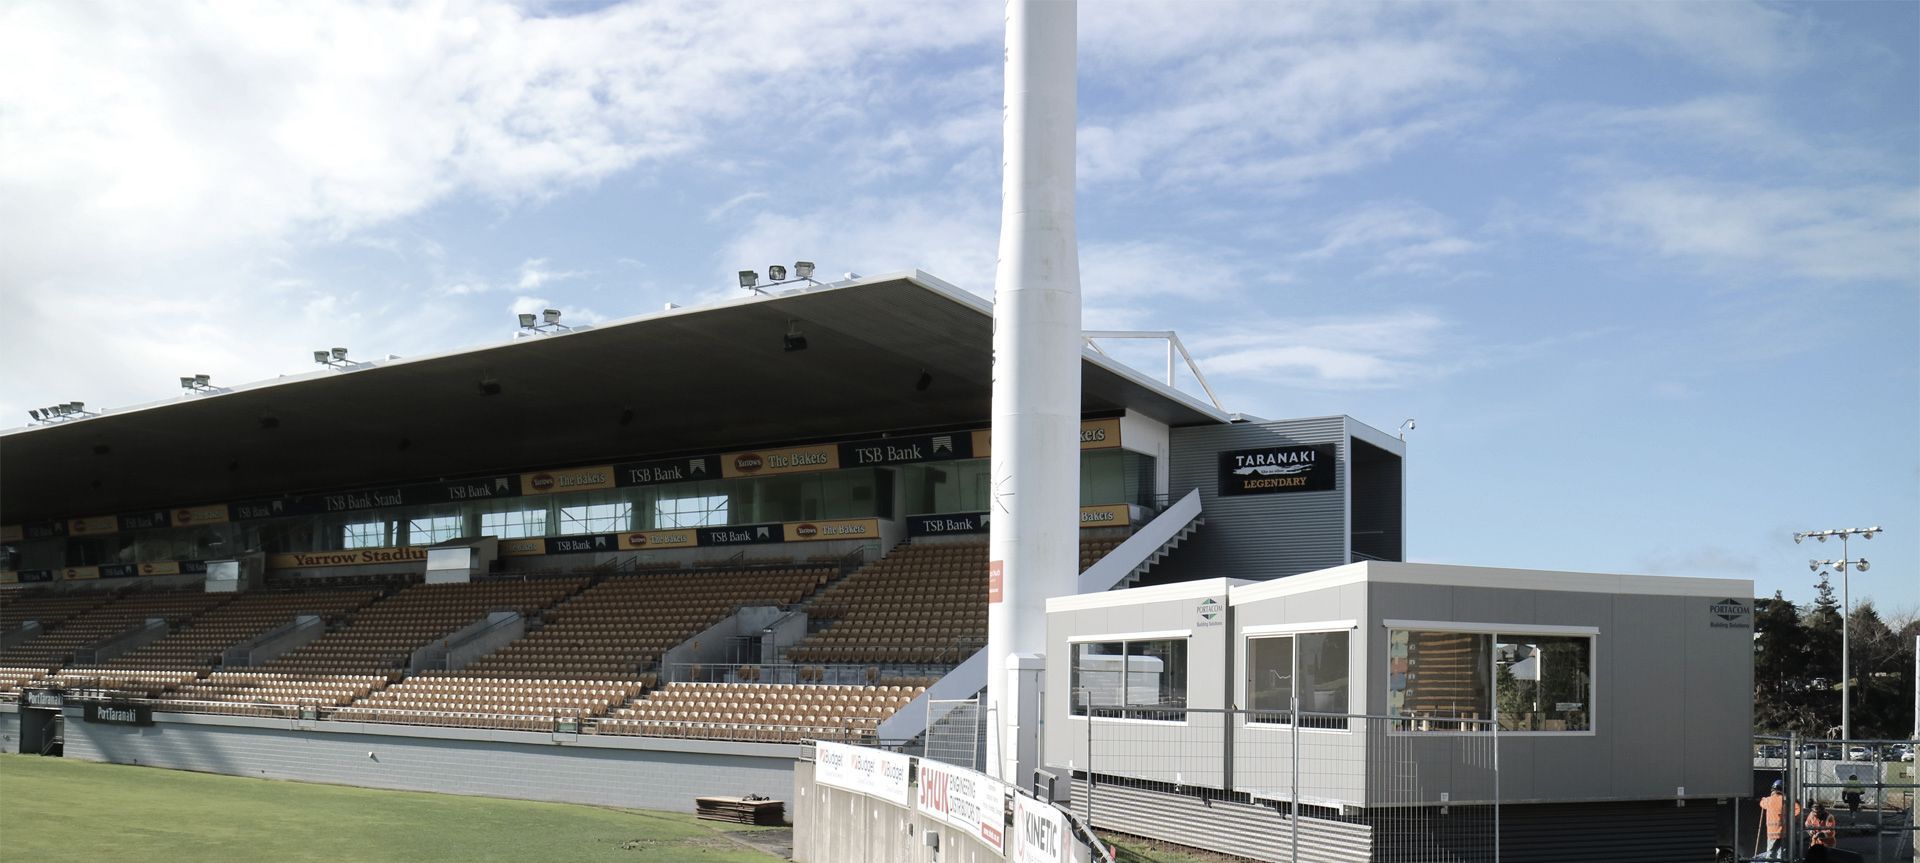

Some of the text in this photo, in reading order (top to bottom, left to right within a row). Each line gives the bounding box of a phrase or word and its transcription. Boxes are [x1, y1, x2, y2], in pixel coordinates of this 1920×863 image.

[1080, 428, 1105, 442] kers
[768, 451, 827, 468] The Bakers
[855, 444, 922, 464] TSB Bank
[1235, 450, 1315, 467] TARANAKI
[559, 472, 606, 487] The Bakers
[629, 465, 683, 483] TSB Bank
[1243, 476, 1308, 489] LEGENDARY
[323, 488, 402, 511] TSB Bank Stand
[449, 484, 492, 499] TSB Bank
[1081, 511, 1114, 522] Bakers
[823, 524, 866, 535] The Bakers
[923, 518, 974, 532] TSB Bank
[710, 530, 752, 543] TSB Bank
[557, 539, 592, 551] TSB Bank
[294, 547, 428, 567] Yarrow Stadiu
[1196, 604, 1223, 614] PORTACOM
[1710, 605, 1750, 614] PORTACOM
[98, 706, 136, 722] PortTaranaki
[825, 748, 844, 770] Budget
[857, 754, 876, 777] Budget
[886, 760, 905, 785] Budget
[920, 766, 949, 814] SHUK
[950, 774, 976, 799] ENGINEERING
[1025, 810, 1057, 858] KINETIC
